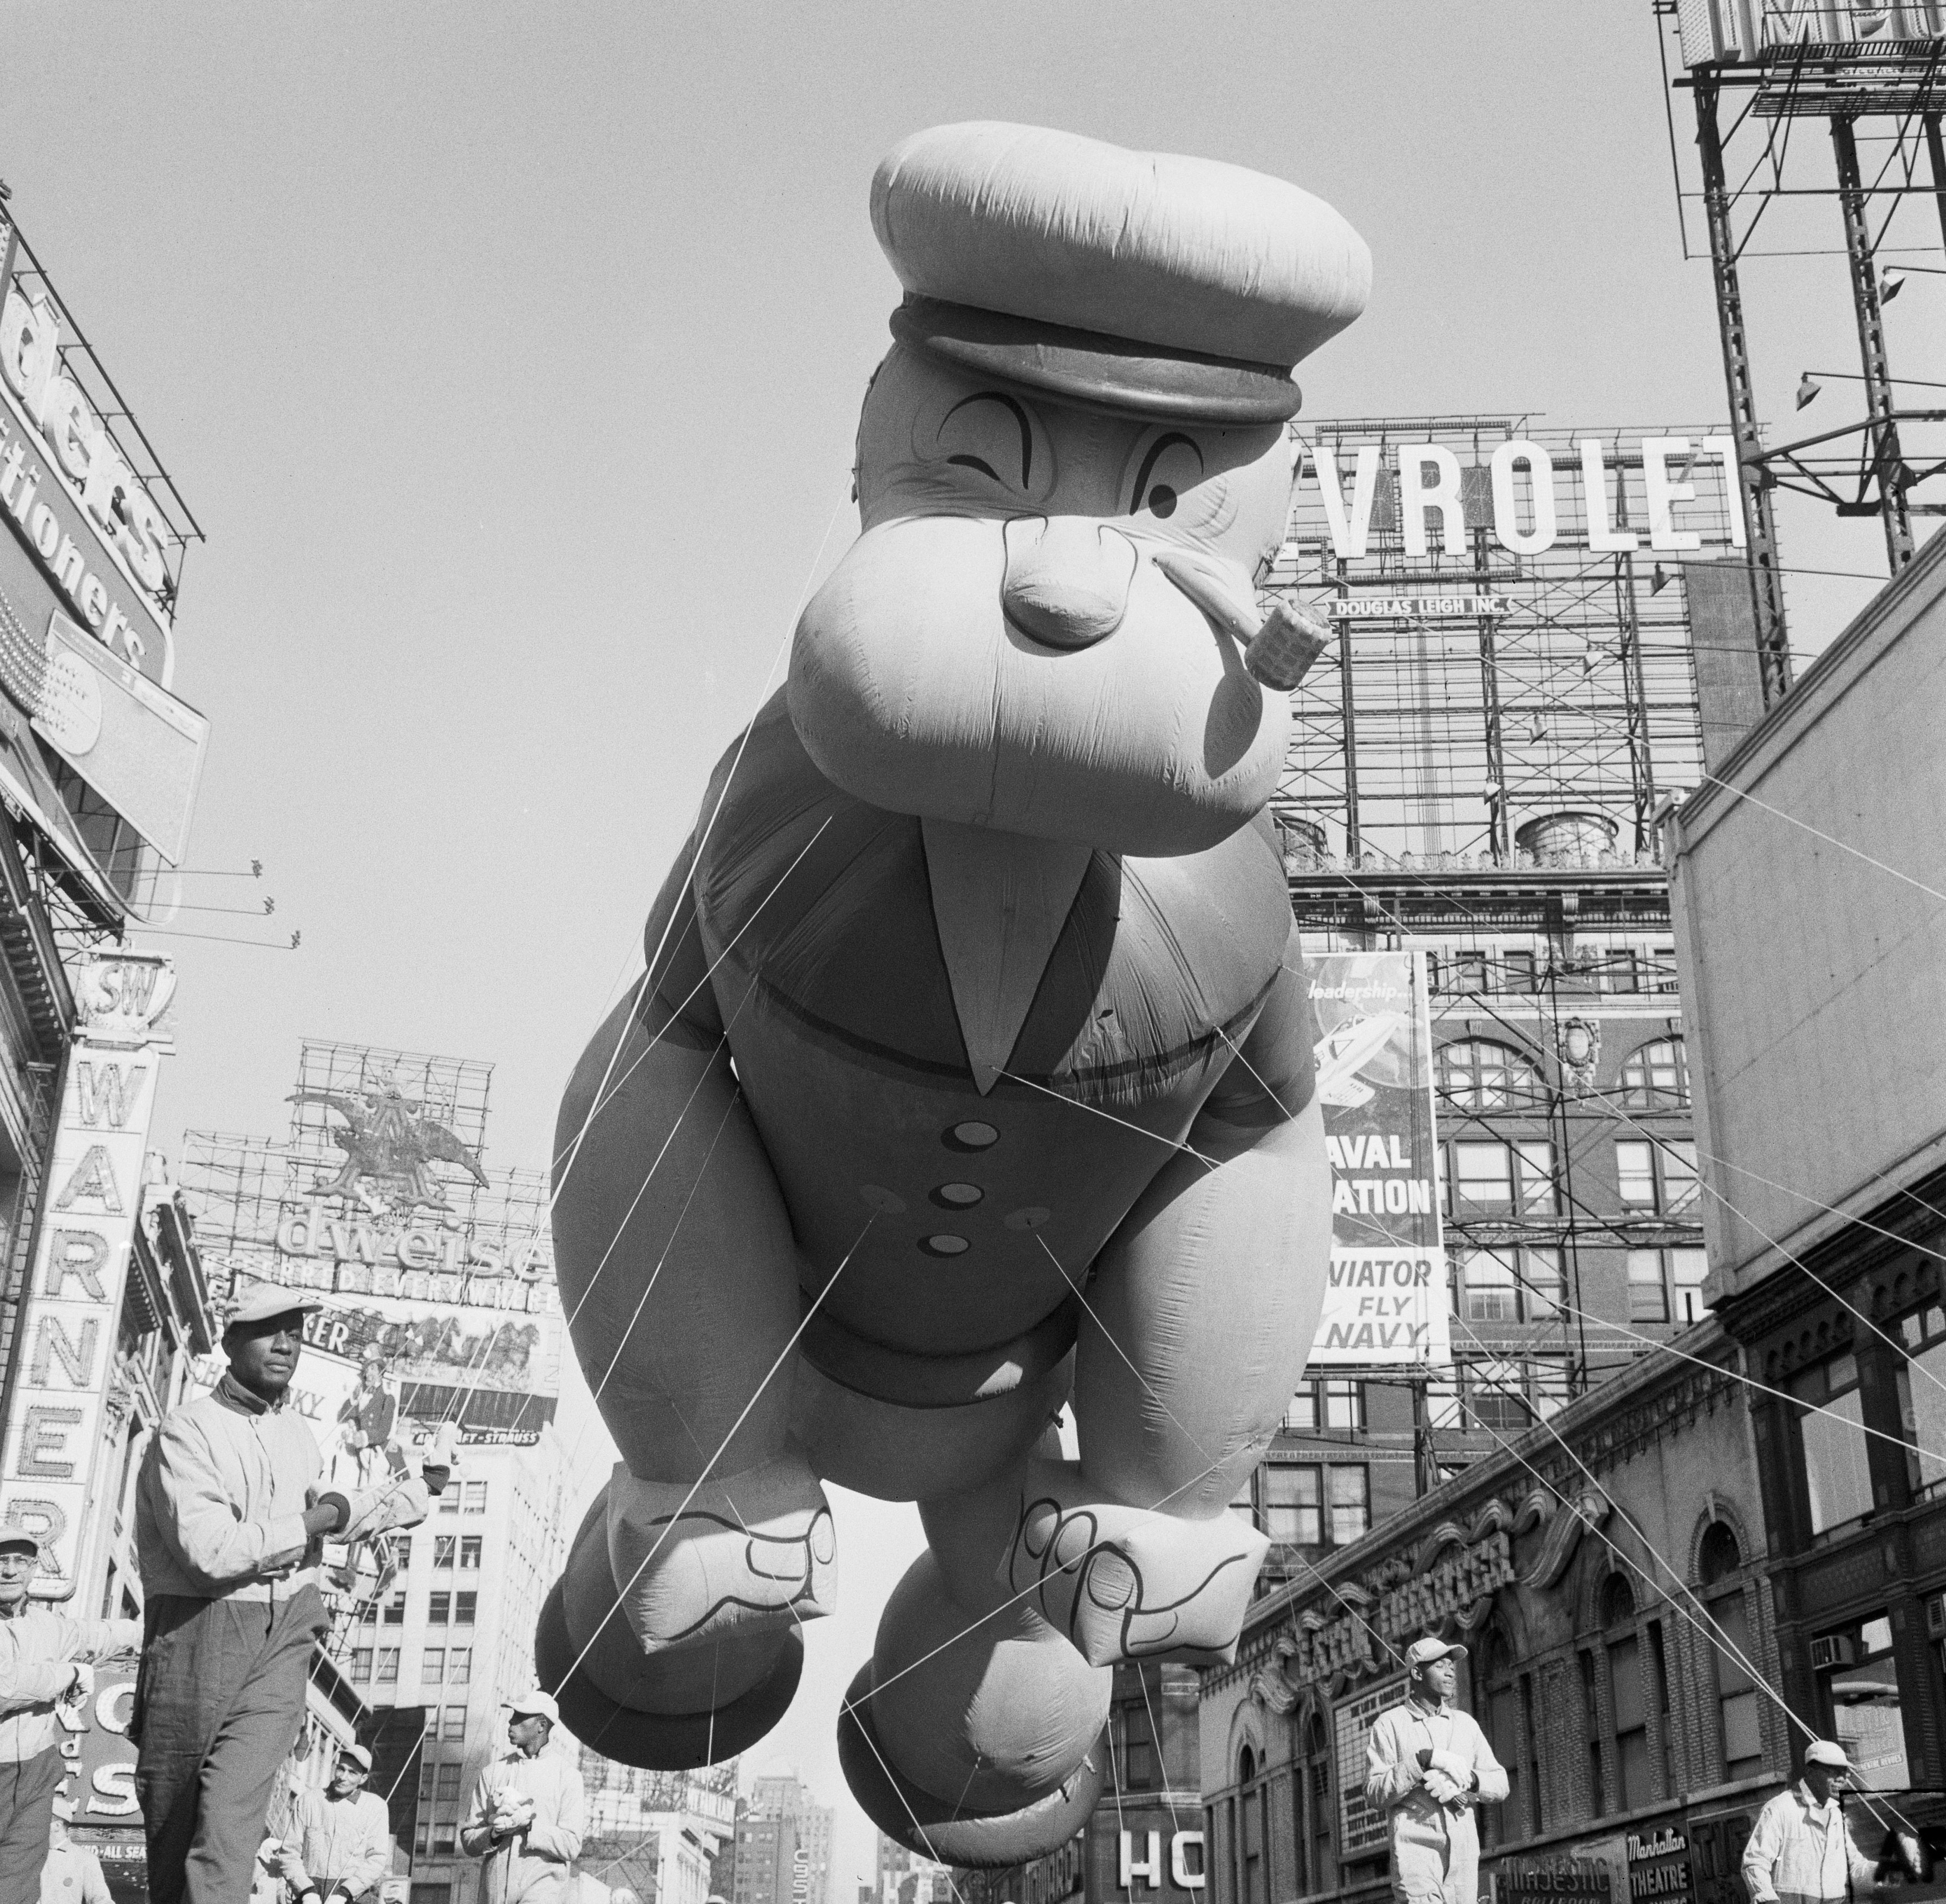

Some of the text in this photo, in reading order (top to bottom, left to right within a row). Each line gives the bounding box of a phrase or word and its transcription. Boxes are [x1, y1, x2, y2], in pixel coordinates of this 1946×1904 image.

[1282, 435, 1747, 560] VROLET
[1336, 597, 1505, 616] DOUGLAS LEIGH INC.
[1325, 1135, 1412, 1169] AVAL
[1333, 1179, 1431, 1214] ATION
[374, 1271, 560, 1314] EVERYWHERE
[1358, 1296, 1412, 1316] FLY
[6, 1061, 147, 1574] WARNER
[1324, 1322, 1431, 1349] NAVY
[1628, 1827, 1686, 1861] Manhattan
[1630, 1863, 1687, 1898] THEATRE
